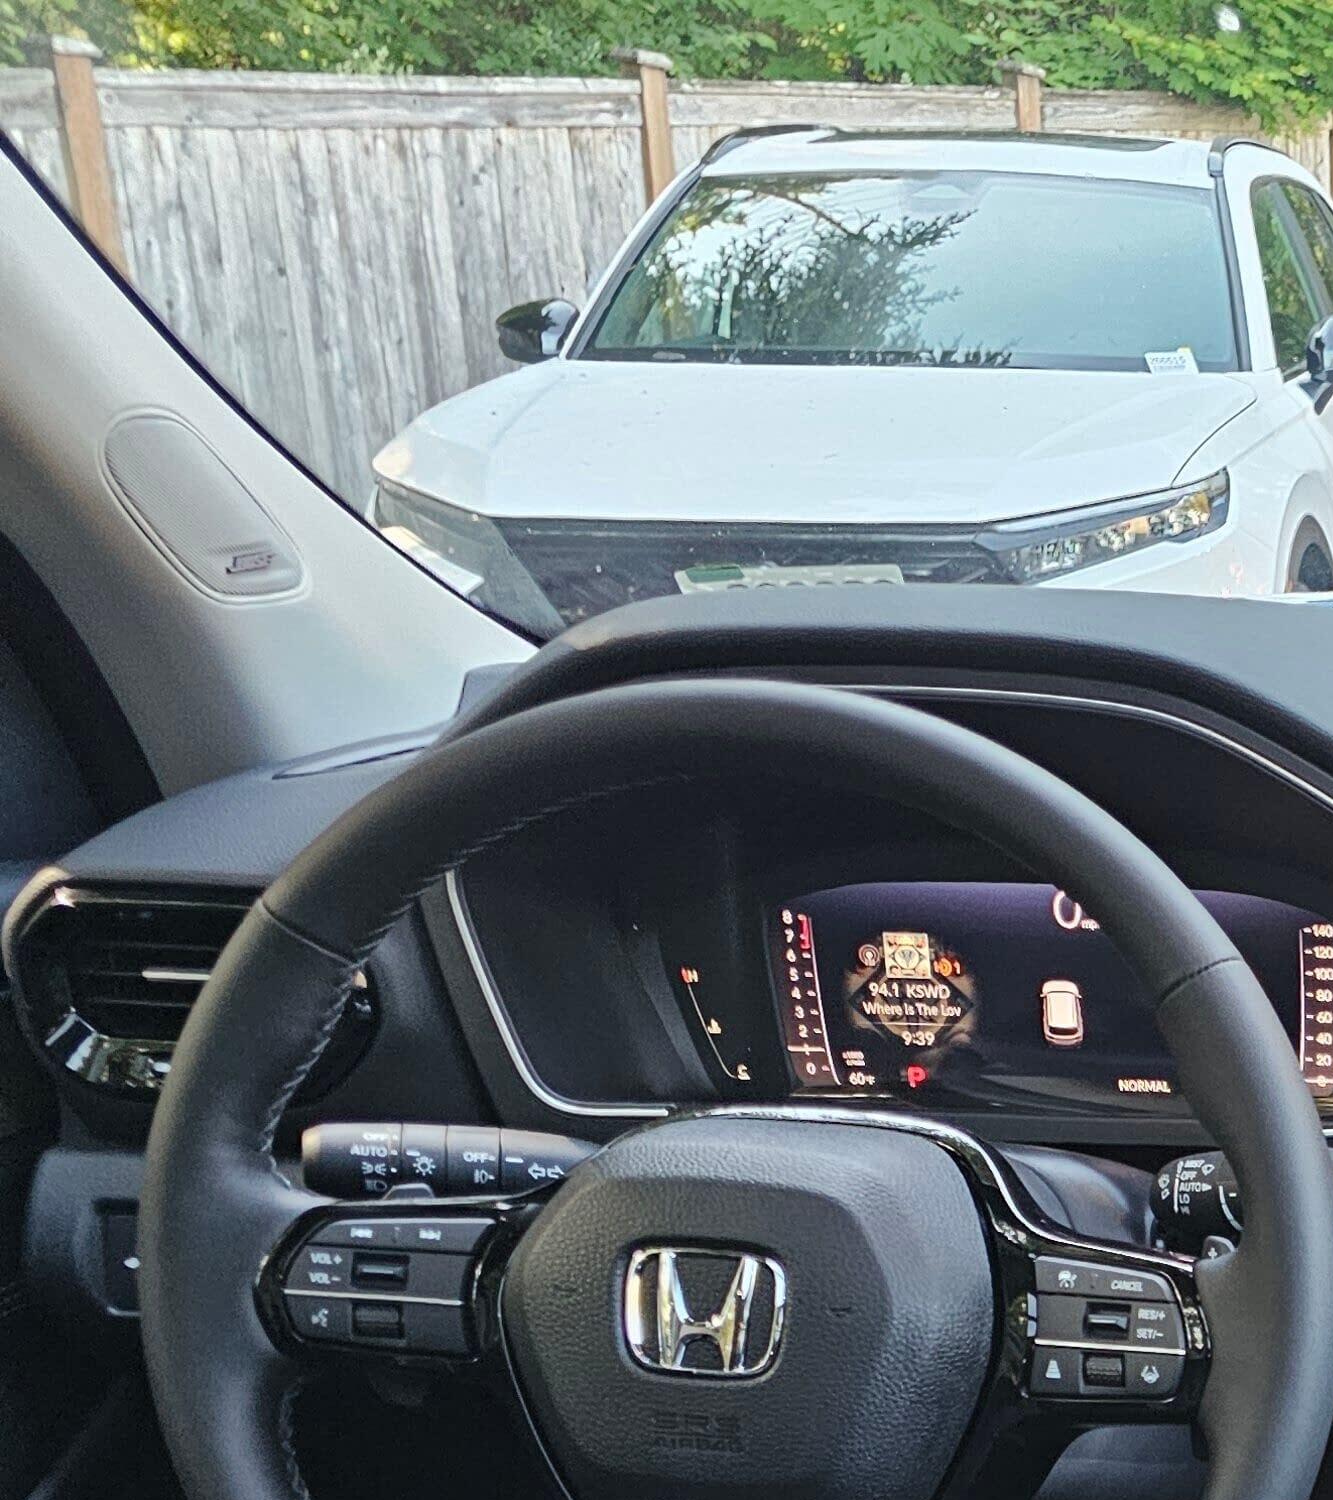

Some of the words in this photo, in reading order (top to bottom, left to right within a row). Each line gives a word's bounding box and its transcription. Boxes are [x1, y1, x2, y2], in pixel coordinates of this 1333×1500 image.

[782, 909, 793, 925] 8
[785, 928, 794, 943] 7
[1312, 924, 1333, 938] 140
[786, 949, 796, 962] 6
[789, 967, 799, 981] 5
[791, 987, 801, 1000] 4
[868, 983, 899, 998] 94.1
[906, 984, 951, 999] KSWD
[1315, 989, 1333, 1003] 80
[795, 1006, 805, 1019] 3
[862, 1002, 902, 1016] Where
[904, 1003, 914, 1016] Is
[916, 1003, 939, 1016] The
[941, 1003, 962, 1017] Lov
[1315, 1011, 1333, 1024] 60
[798, 1025, 808, 1037] 2
[901, 1031, 936, 1047] 9:39
[1315, 1032, 1333, 1045] 40
[1315, 1054, 1332, 1067] 20
[806, 1062, 816, 1075] 0
[907, 1064, 928, 1088] P
[1118, 1079, 1171, 1093] NORMAL
[362, 1132, 389, 1141] OFF
[350, 1145, 388, 1157] AUTO
[463, 1151, 490, 1163] OFF
[1180, 1170, 1197, 1180] OFF
[1179, 1182, 1201, 1192] AUTO
[1110, 1279, 1143, 1292] CANCEL
